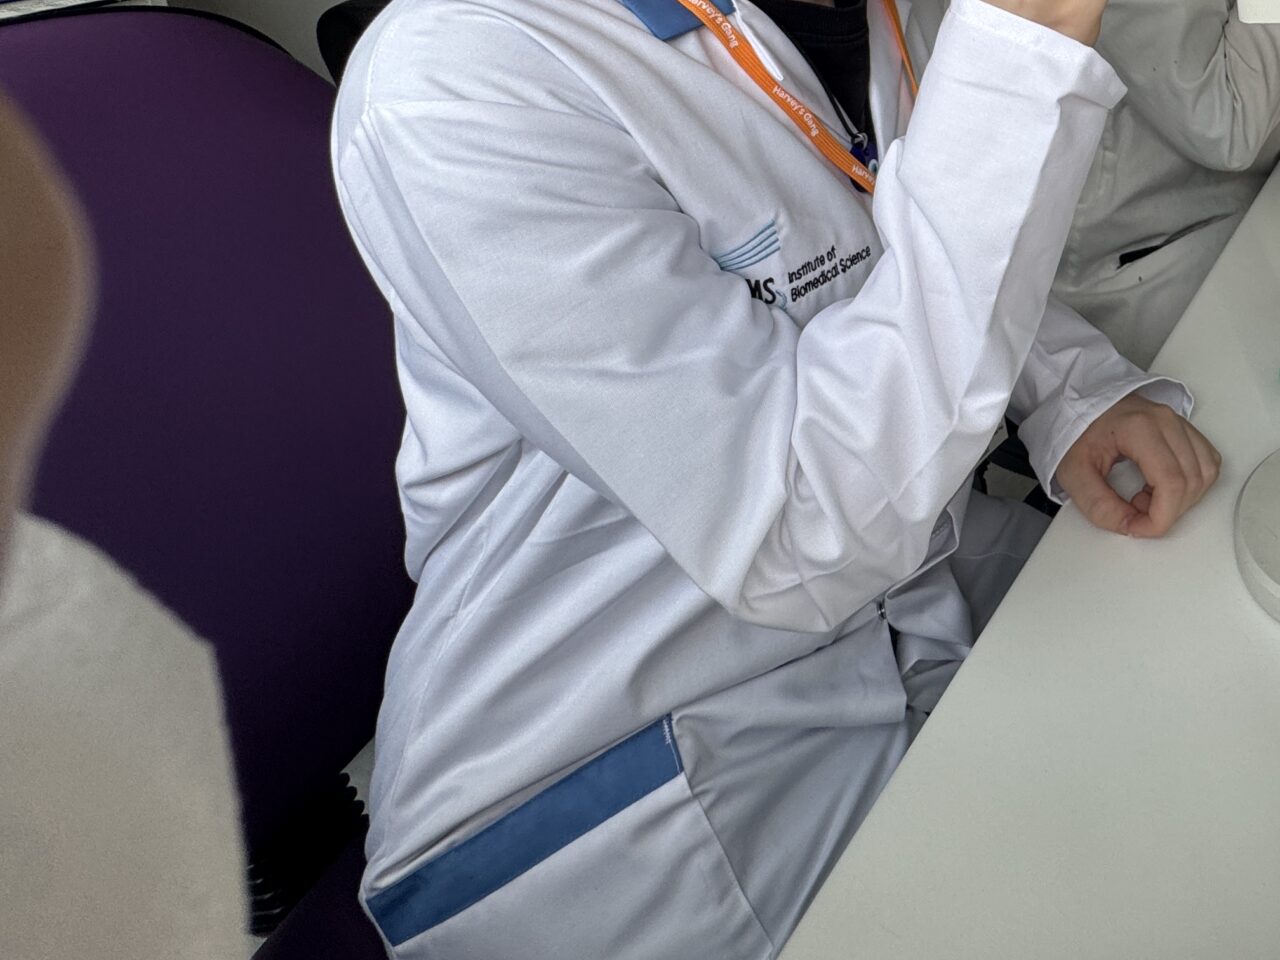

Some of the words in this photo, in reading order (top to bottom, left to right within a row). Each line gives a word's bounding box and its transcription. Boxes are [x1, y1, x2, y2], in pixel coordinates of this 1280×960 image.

[721, 21, 739, 49] Gang
[772, 85, 805, 115] Harvey's
[803, 112, 820, 137] Gang
[788, 255, 826, 285] Institute
[826, 244, 837, 262] of
[790, 263, 840, 302] Biomedical
[839, 245, 871, 273] Science
[745, 276, 777, 305] MS
